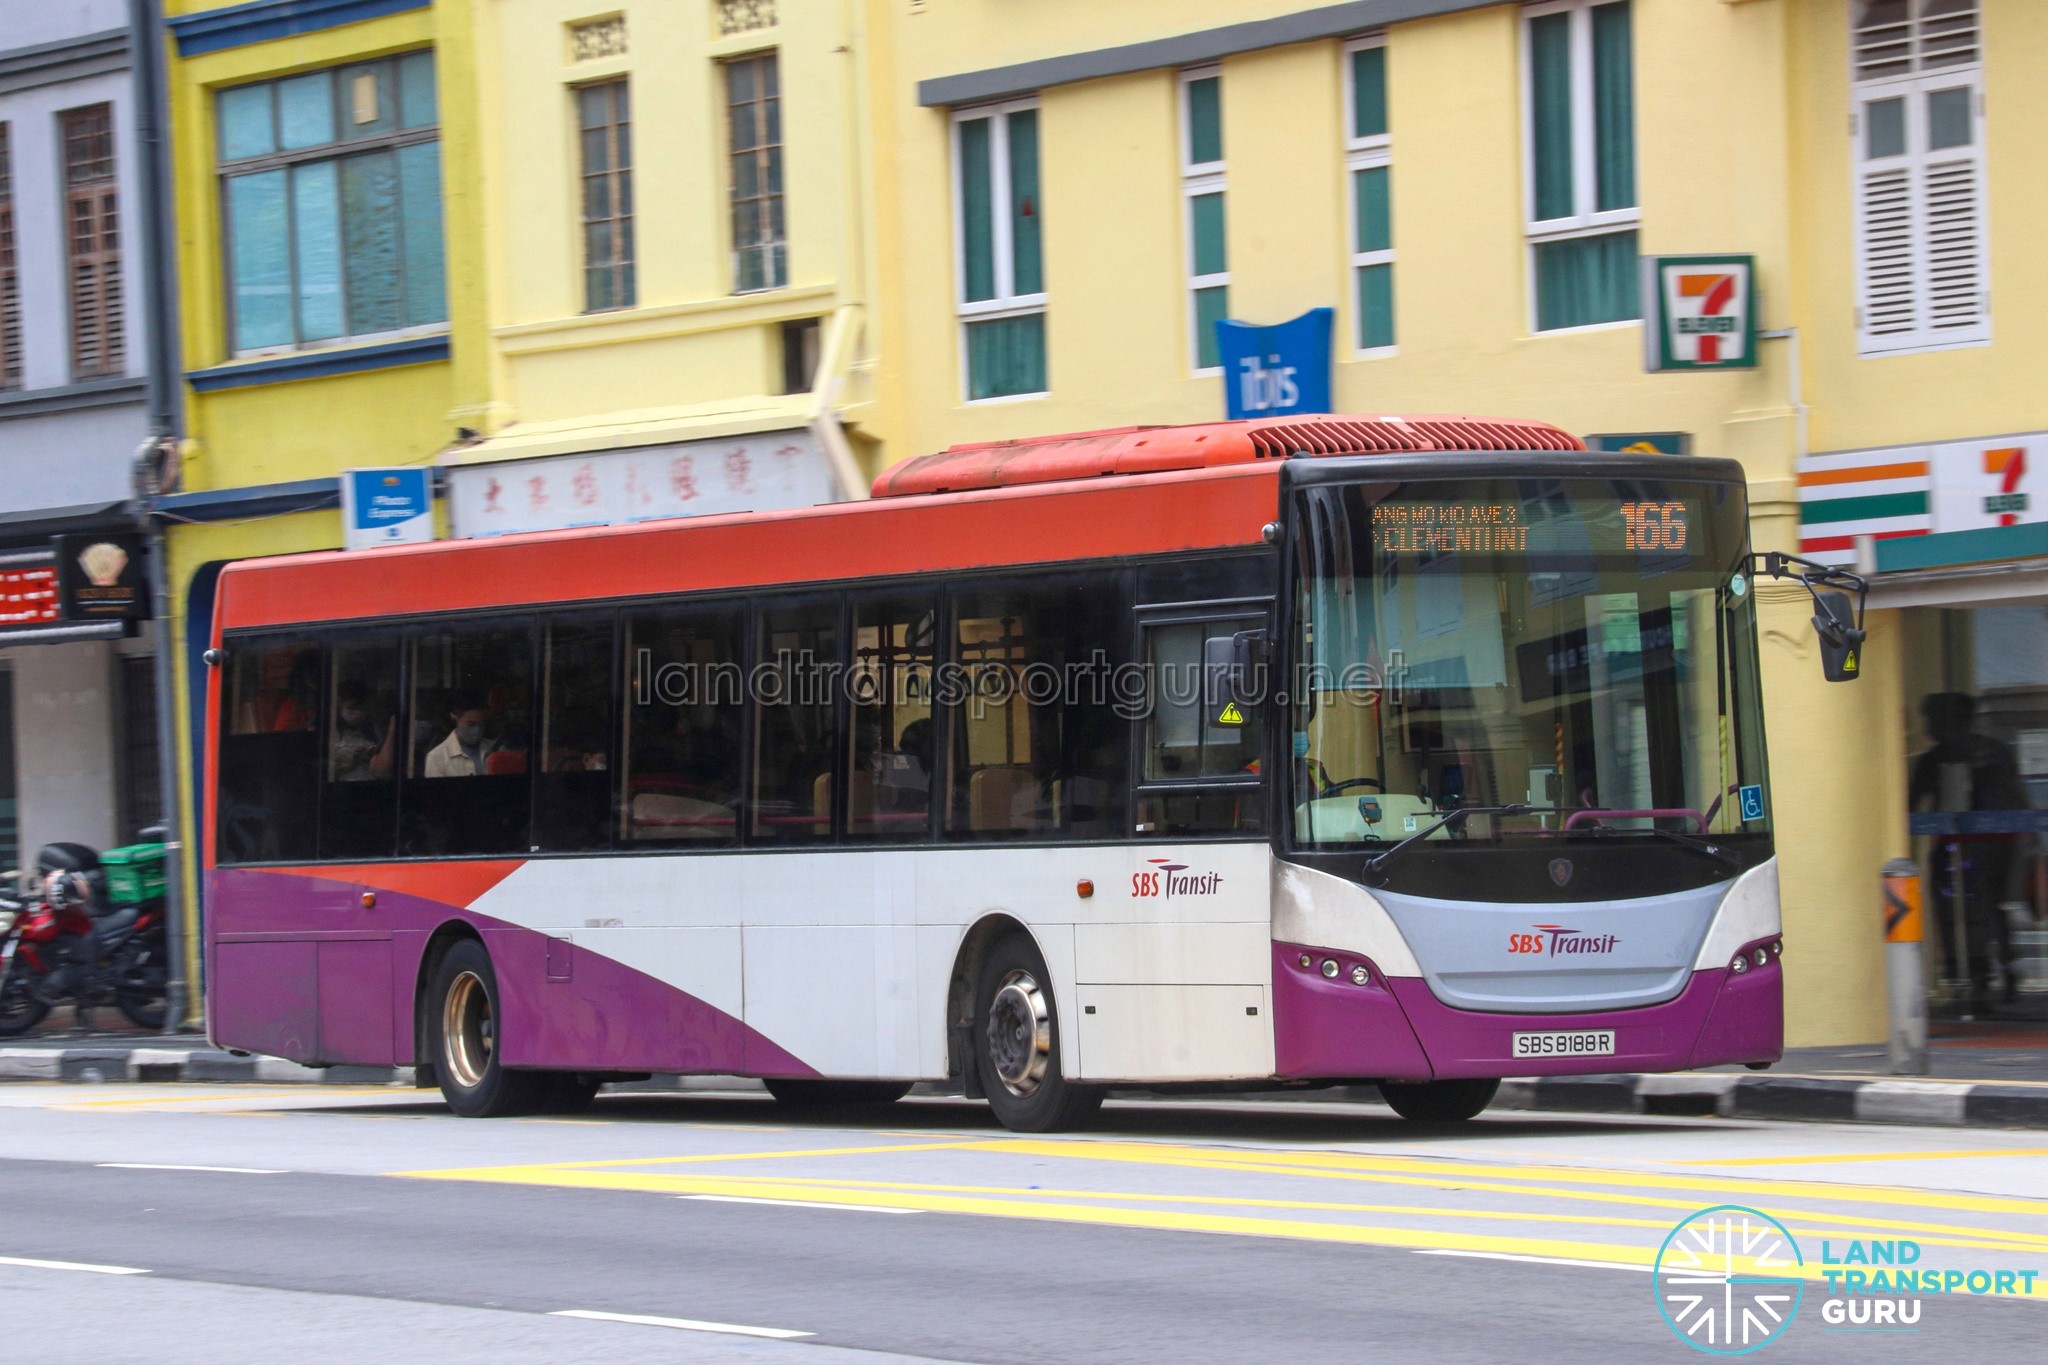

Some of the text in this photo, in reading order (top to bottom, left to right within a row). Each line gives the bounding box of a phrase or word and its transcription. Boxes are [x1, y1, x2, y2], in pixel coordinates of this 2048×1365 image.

[1240, 353, 1299, 411] ibis
[1373, 506, 1516, 524] ANG MO KIO AVE 3
[1620, 501, 1687, 550] 166
[1131, 864, 1224, 900] SBS Transit
[1508, 929, 1622, 958] SBS Transit
